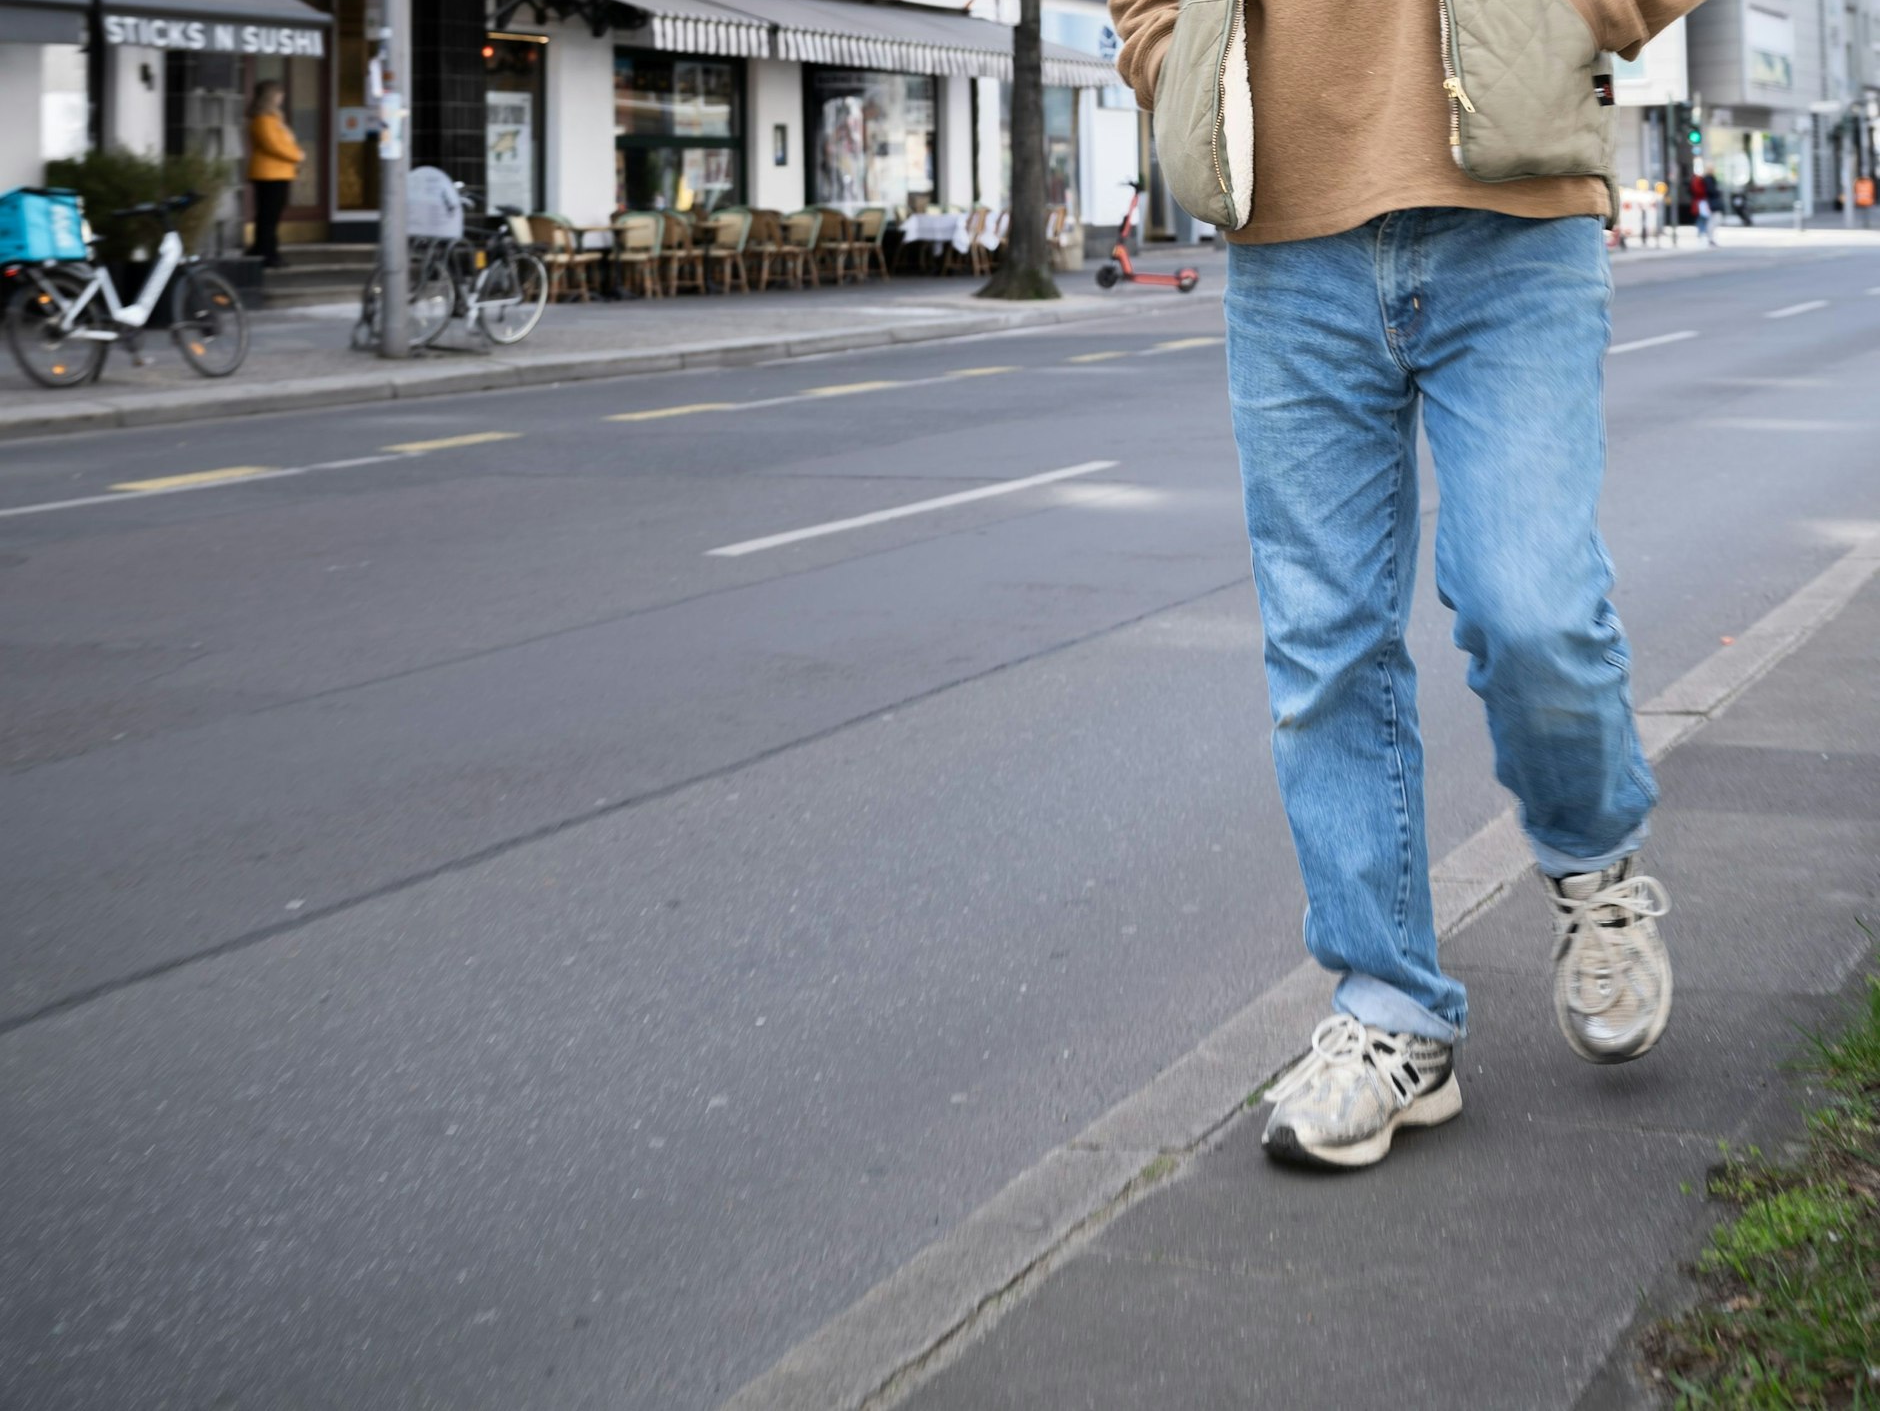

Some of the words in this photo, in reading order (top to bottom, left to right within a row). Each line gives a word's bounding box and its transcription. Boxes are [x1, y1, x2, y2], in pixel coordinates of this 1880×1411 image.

[104, 14, 206, 50] STICKS
[214, 24, 235, 51] N
[242, 25, 324, 57] SUSHI
